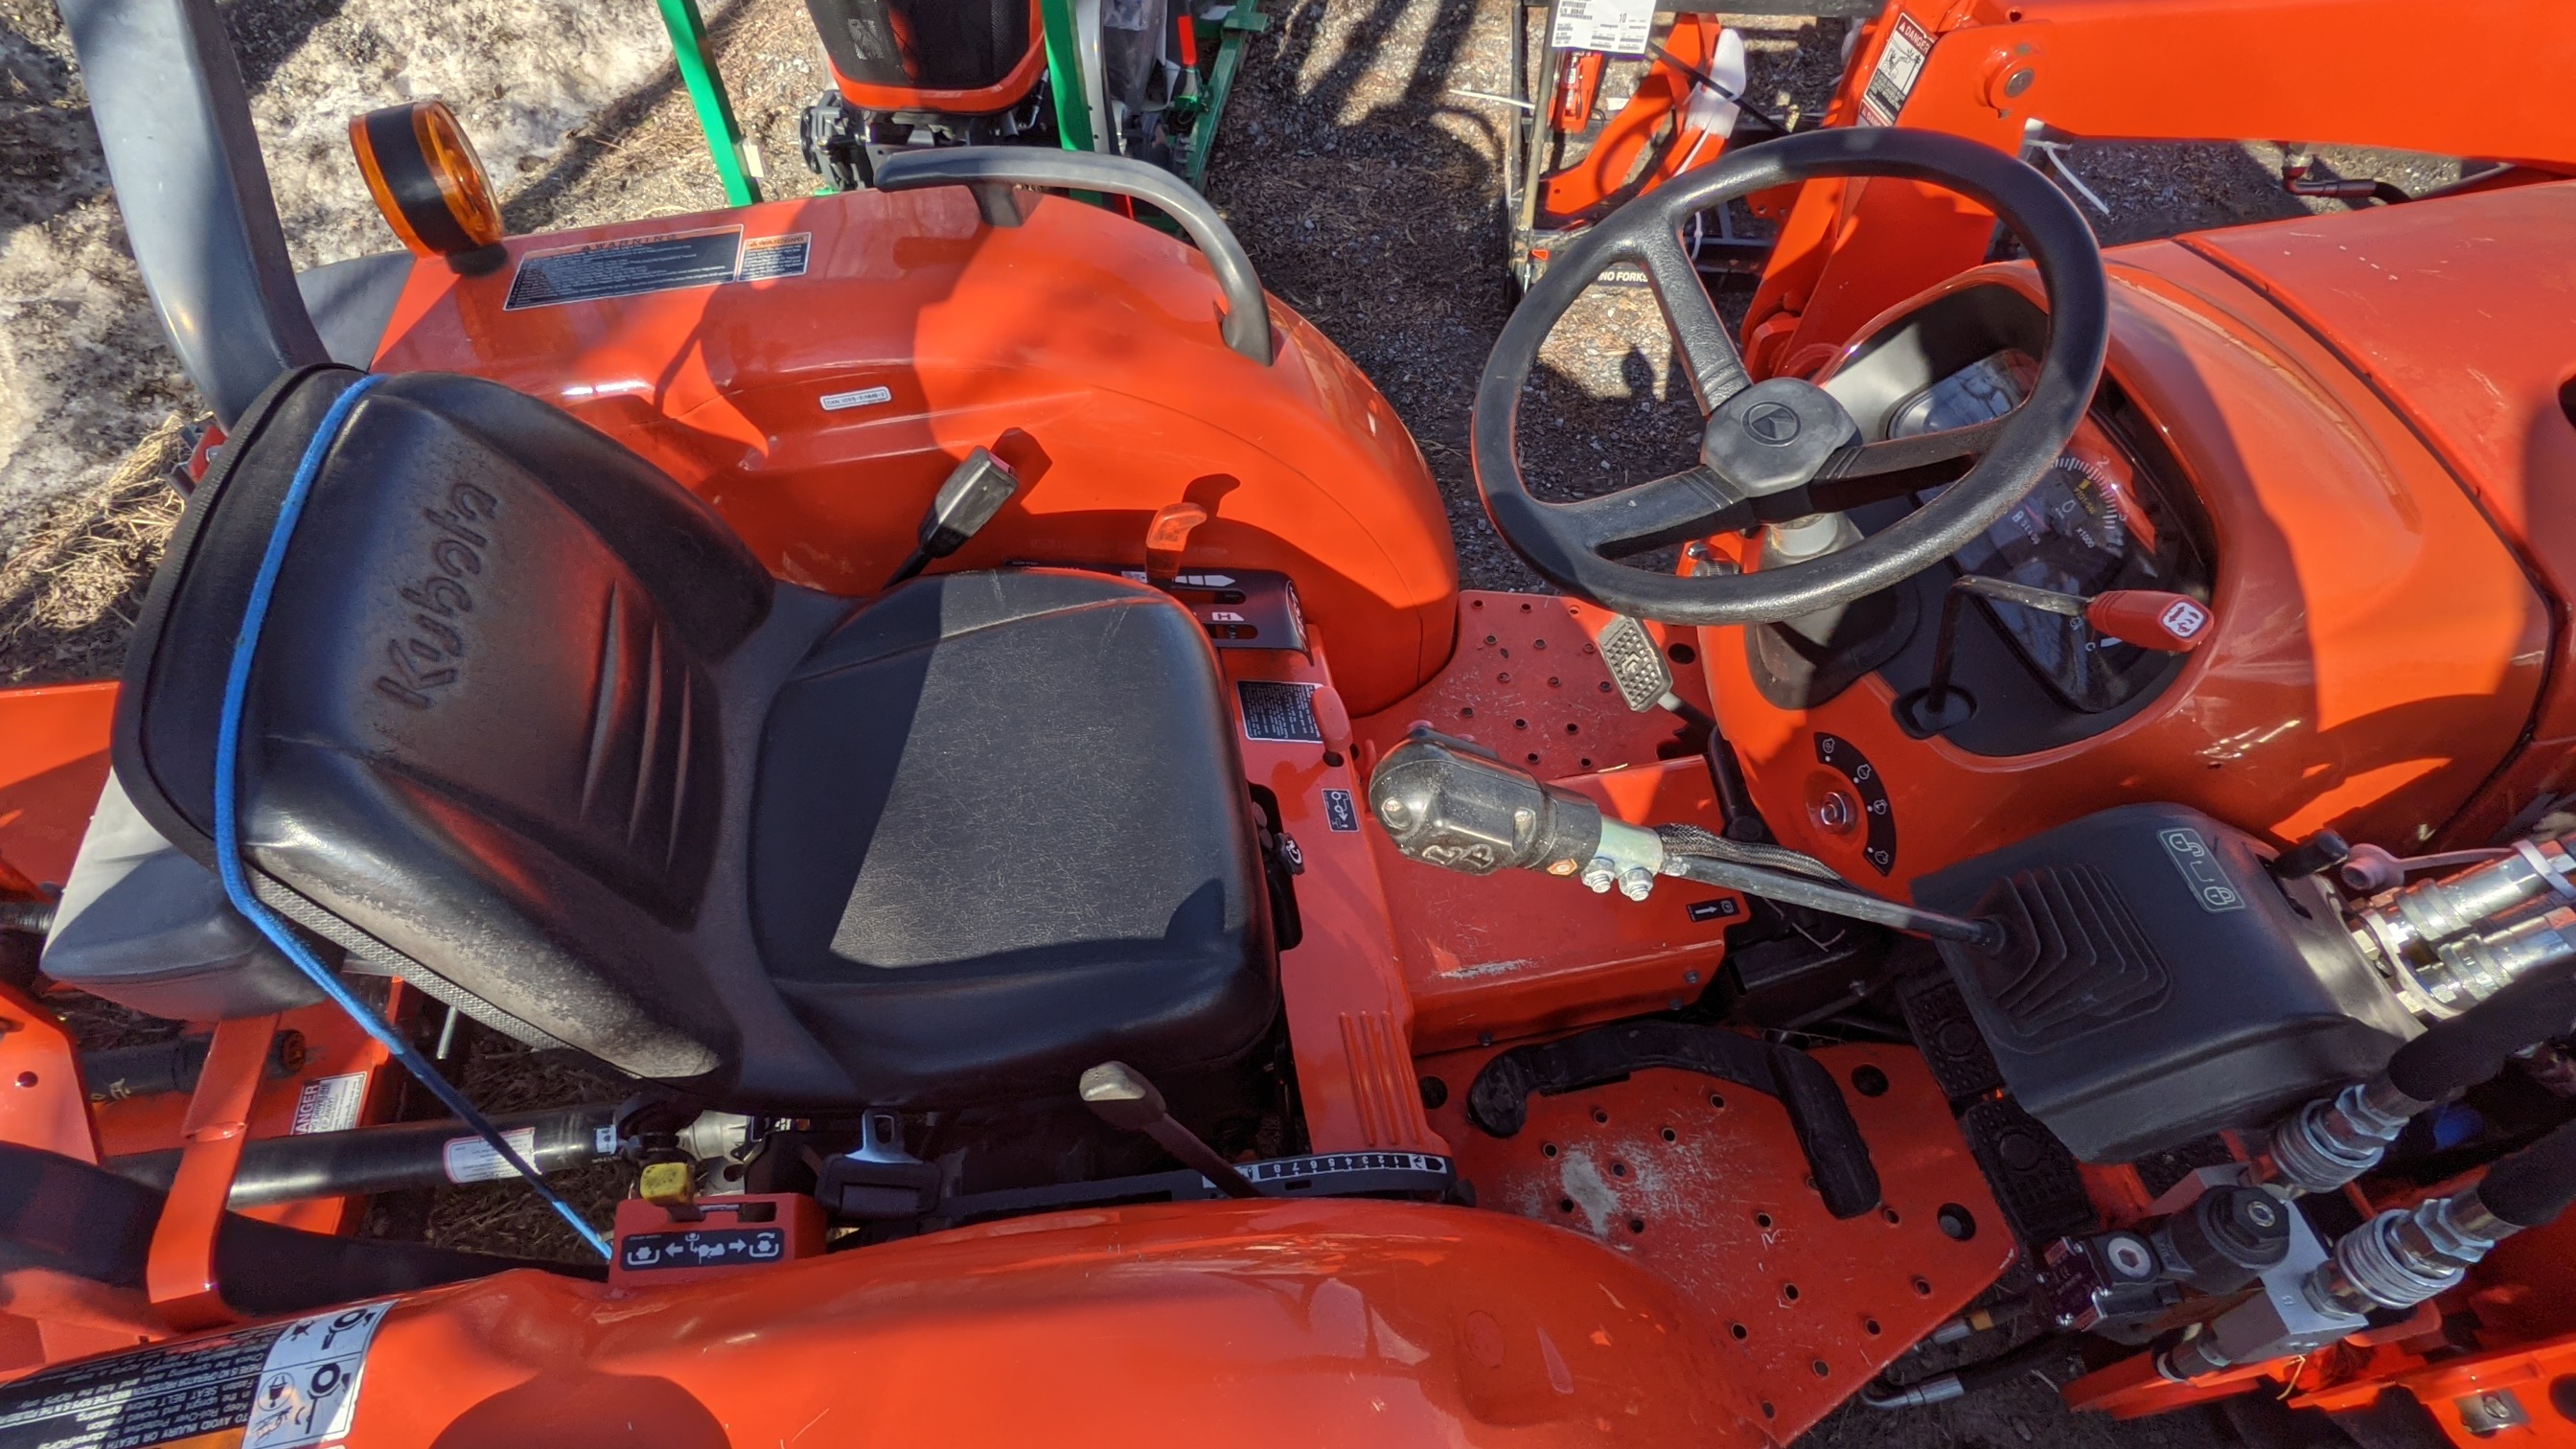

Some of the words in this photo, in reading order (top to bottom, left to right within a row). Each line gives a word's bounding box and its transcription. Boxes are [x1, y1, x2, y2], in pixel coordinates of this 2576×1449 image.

[1904, 26, 1931, 54] DANGER
[1598, 271, 1615, 281] NO
[372, 482, 498, 710] Kubota
[294, 1085, 319, 1134] ANGER
[158, 1392, 187, 1407] BELT
[191, 1385, 218, 1399] SEAT
[200, 1415, 233, 1430] AVOID
[234, 1413, 248, 1423] TO
[142, 1431, 158, 1442] OR
[161, 1422, 198, 1438] INJURY
